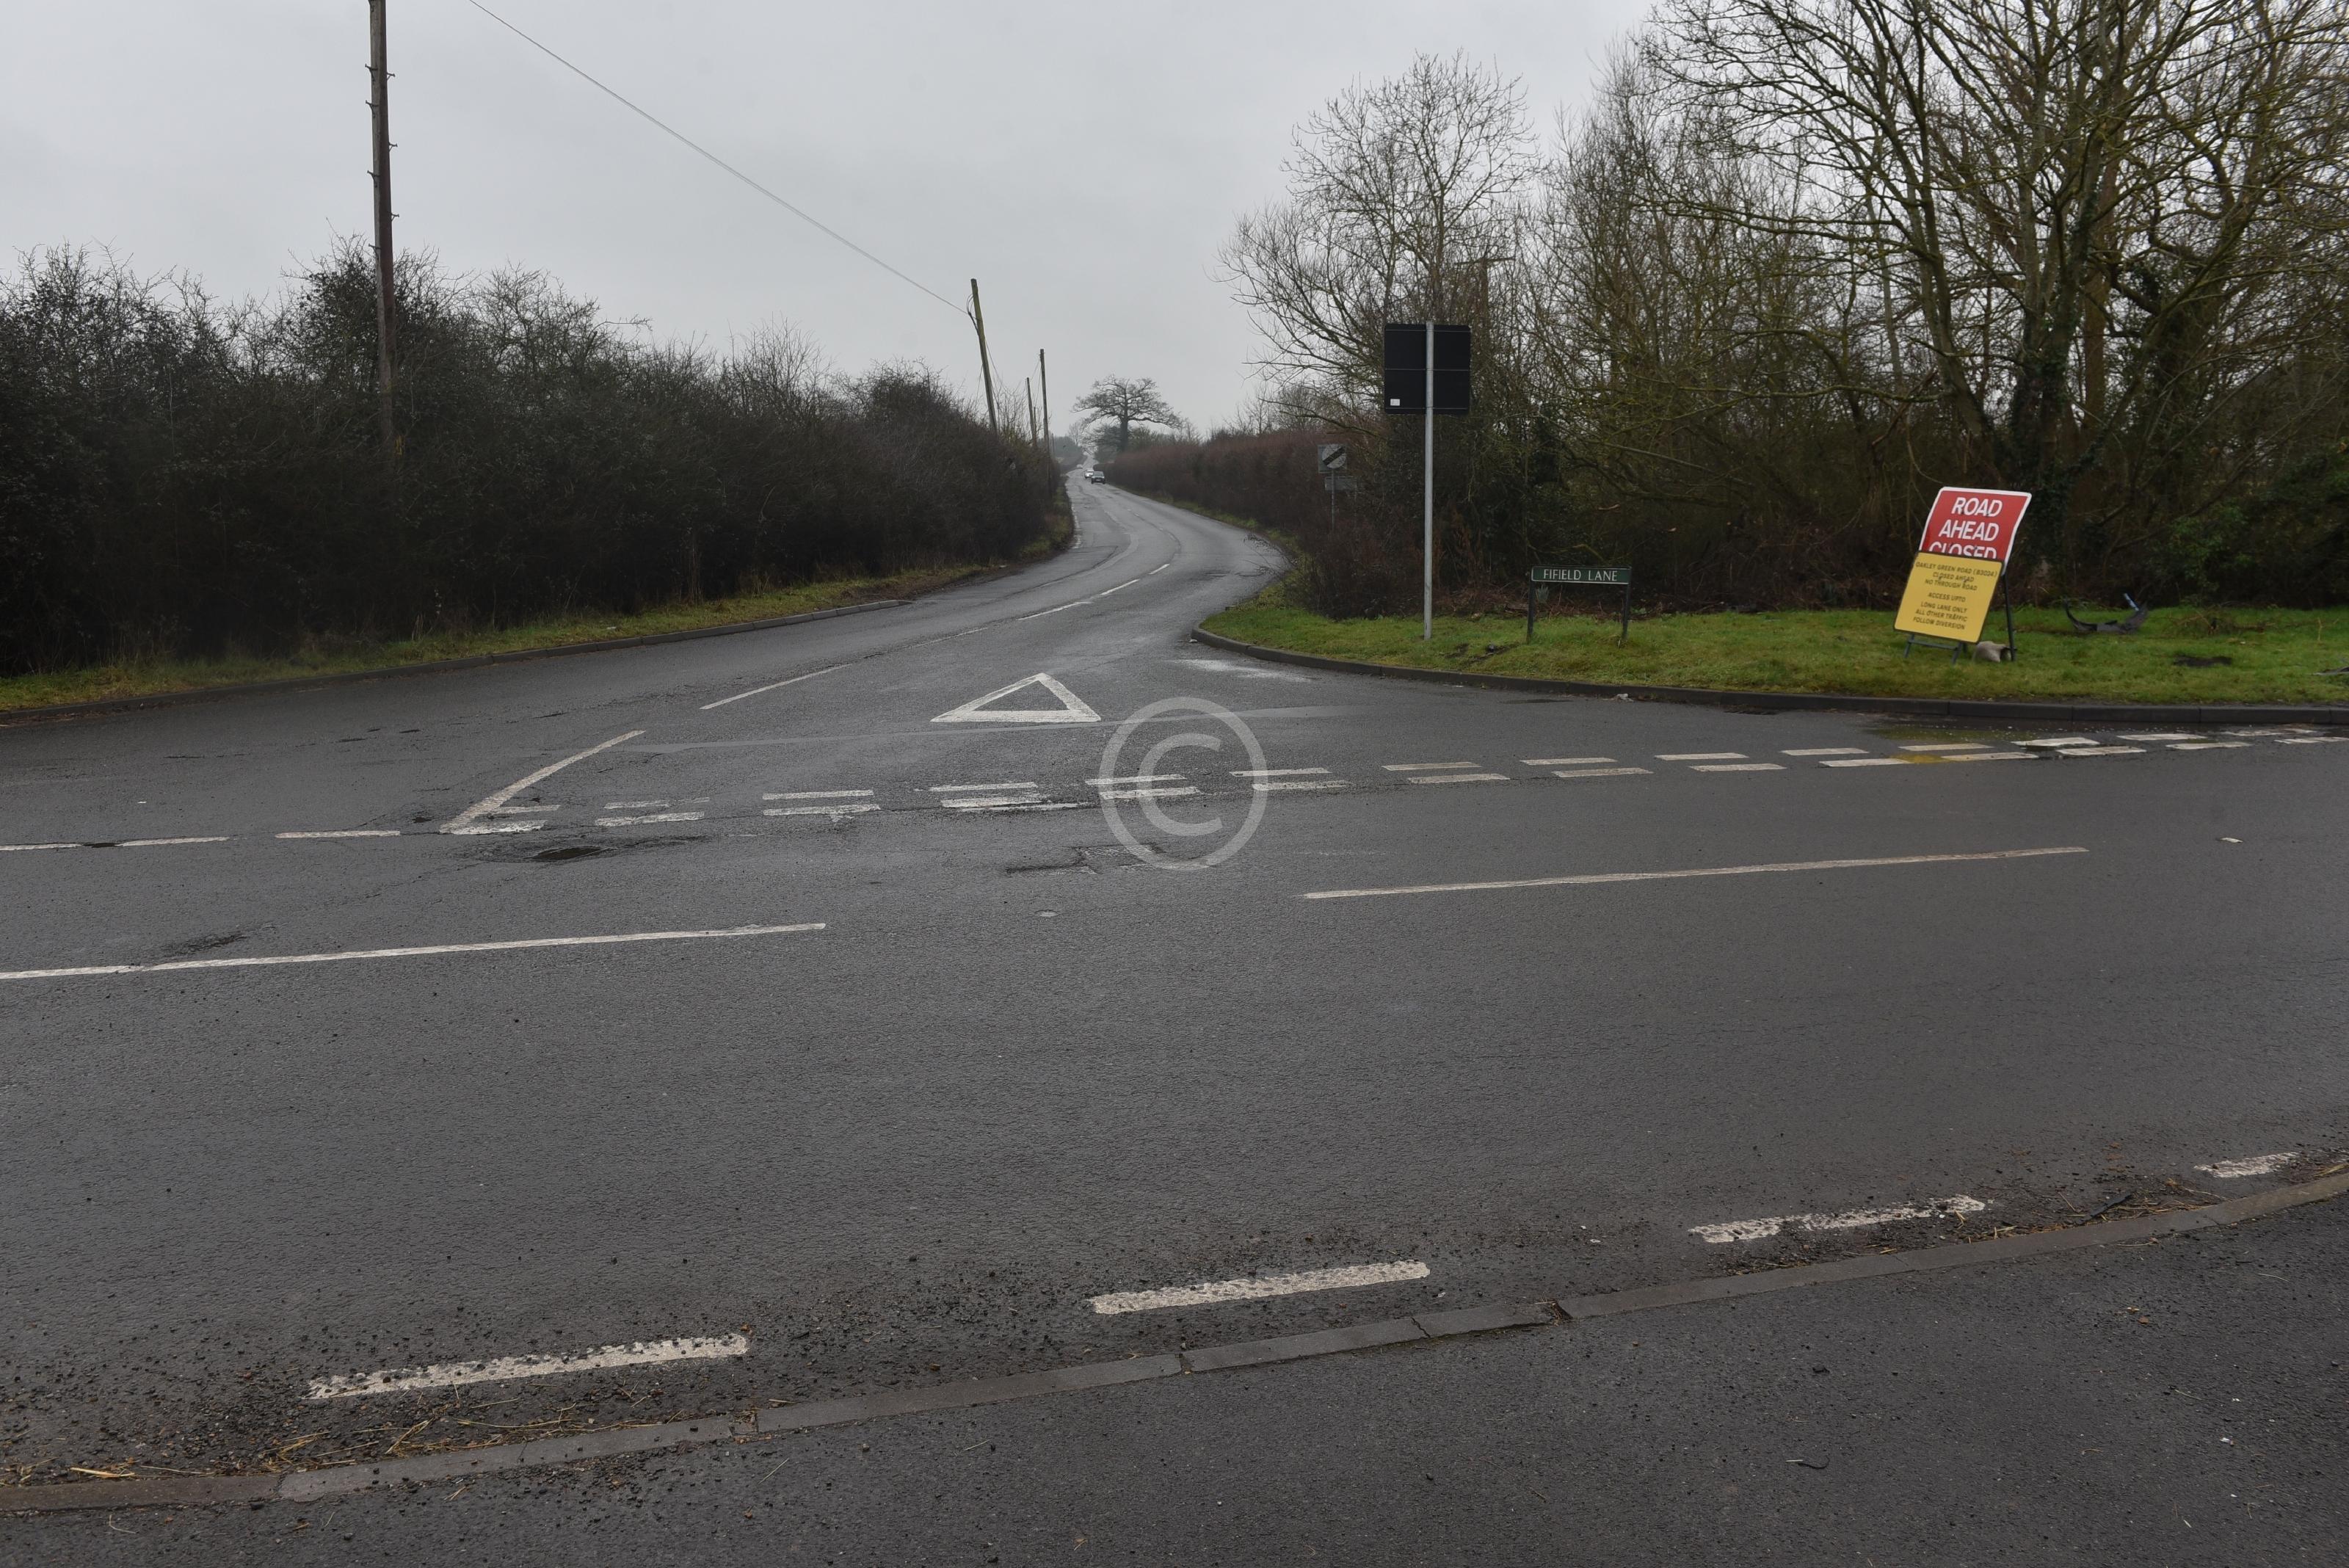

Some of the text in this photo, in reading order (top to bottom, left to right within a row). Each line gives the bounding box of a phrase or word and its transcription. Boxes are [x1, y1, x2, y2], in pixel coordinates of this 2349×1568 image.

[1951, 497, 2003, 517] ROAD
[1938, 519, 2000, 541] AHEAD
[1937, 564, 1956, 572] GREEN
[1543, 569, 1617, 581] FIFIELD LANE
[1933, 572, 1954, 580] CLOSED
[1934, 580, 1961, 588] THROUGH
[1962, 583, 1978, 591] ROAD
[1928, 592, 1950, 600] ACCESS
[1913, 616, 1965, 630] FOLLOW DIVERSION
[1945, 613, 1968, 622] TRAFFIC
